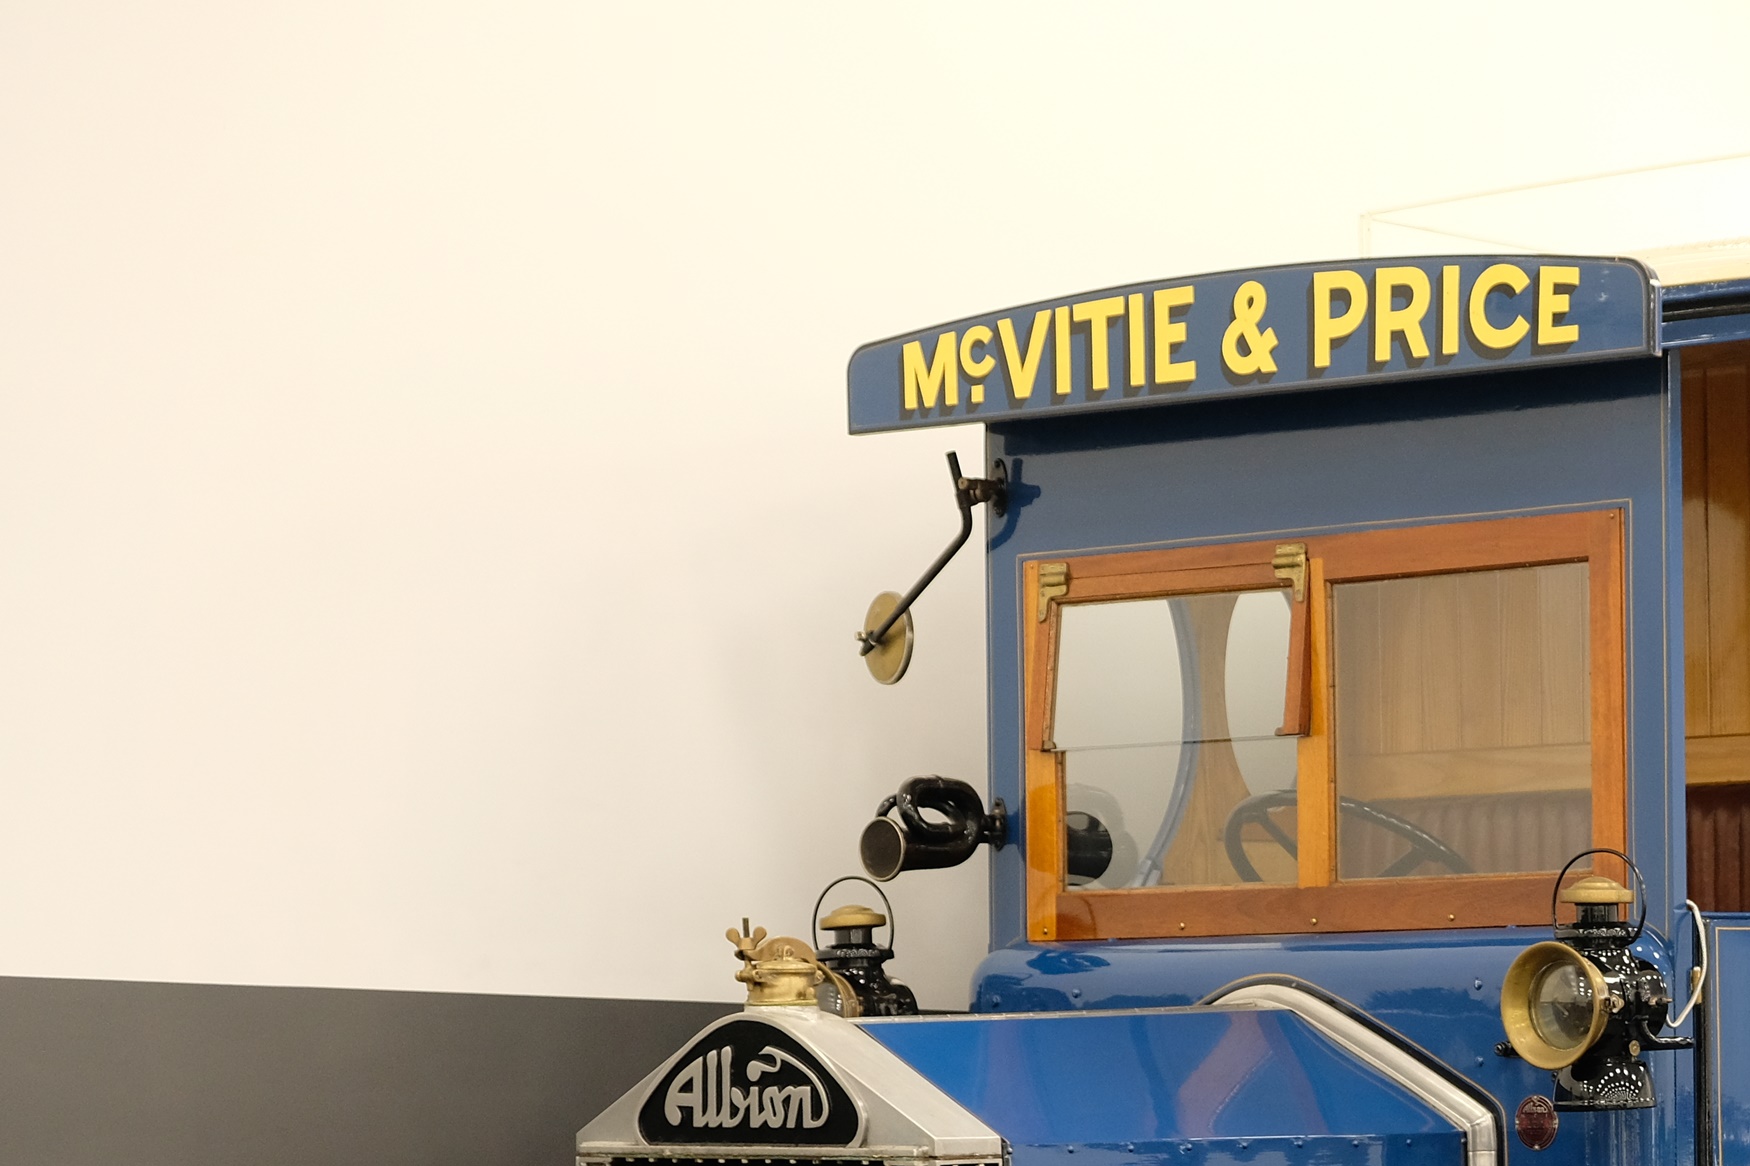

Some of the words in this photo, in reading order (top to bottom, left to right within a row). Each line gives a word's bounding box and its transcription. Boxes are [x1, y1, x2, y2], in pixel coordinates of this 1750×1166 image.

[1221, 280, 1279, 376] &
[1313, 263, 1581, 369] PRICE
[663, 1045, 830, 1129] Albion
